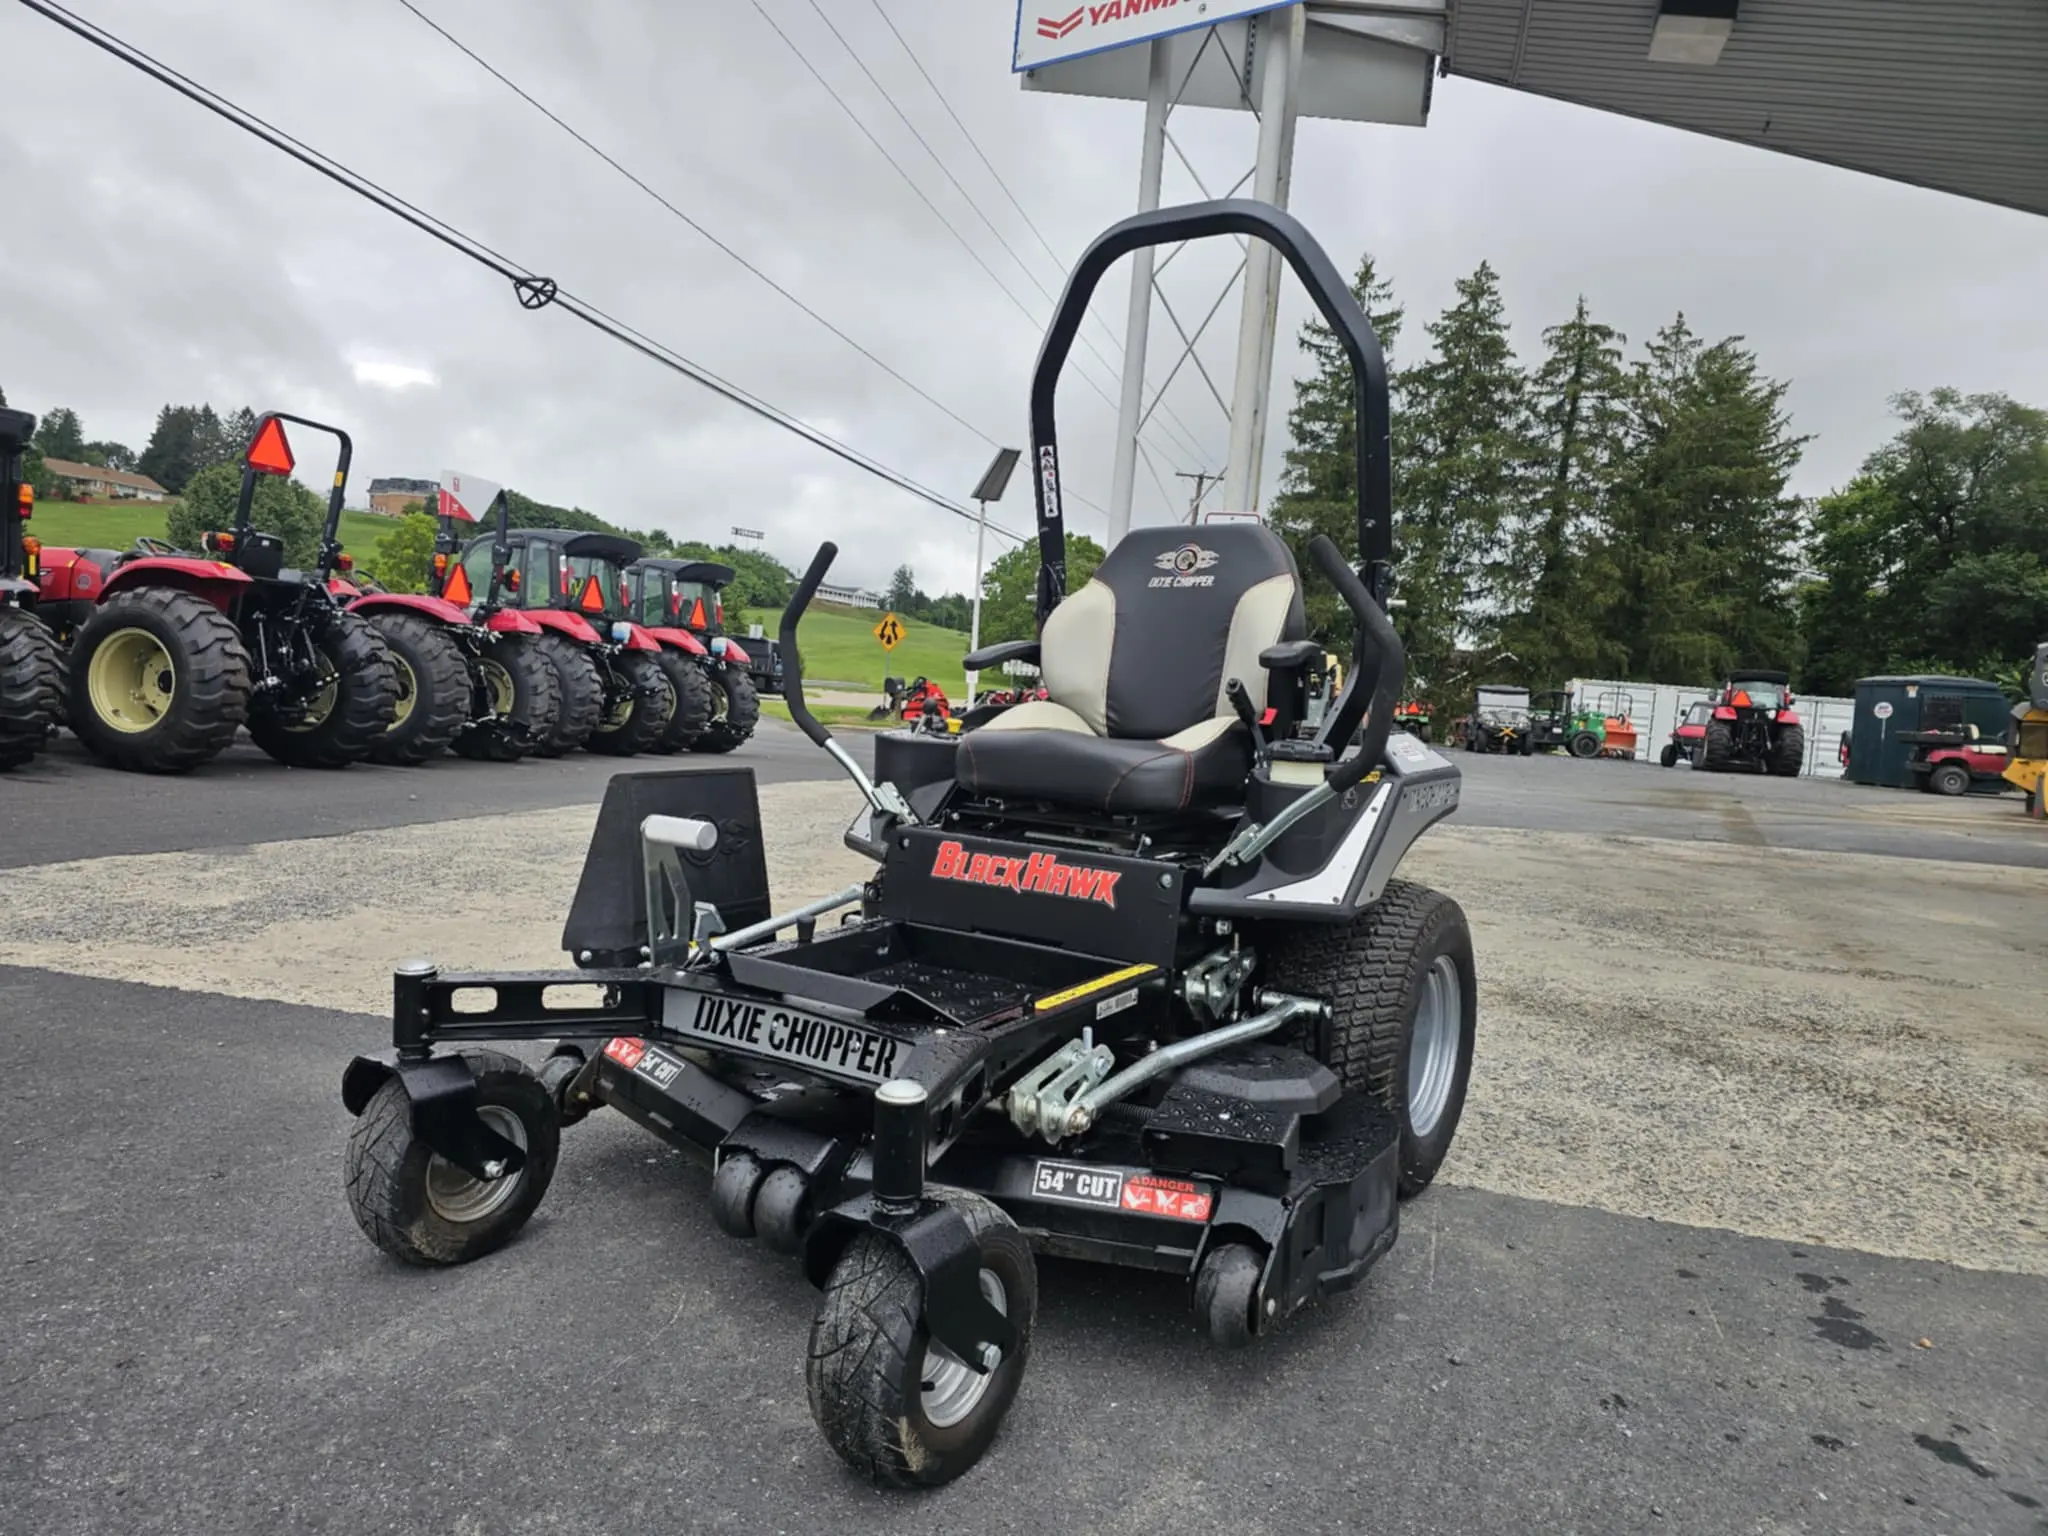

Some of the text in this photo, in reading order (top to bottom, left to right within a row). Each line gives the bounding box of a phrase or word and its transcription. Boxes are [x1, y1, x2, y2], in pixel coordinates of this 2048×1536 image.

[693, 995, 897, 1079] DIXIE CHOPPER
[1076, 1174, 1118, 1199] CUT
[1140, 1175, 1195, 1193] DANGER
